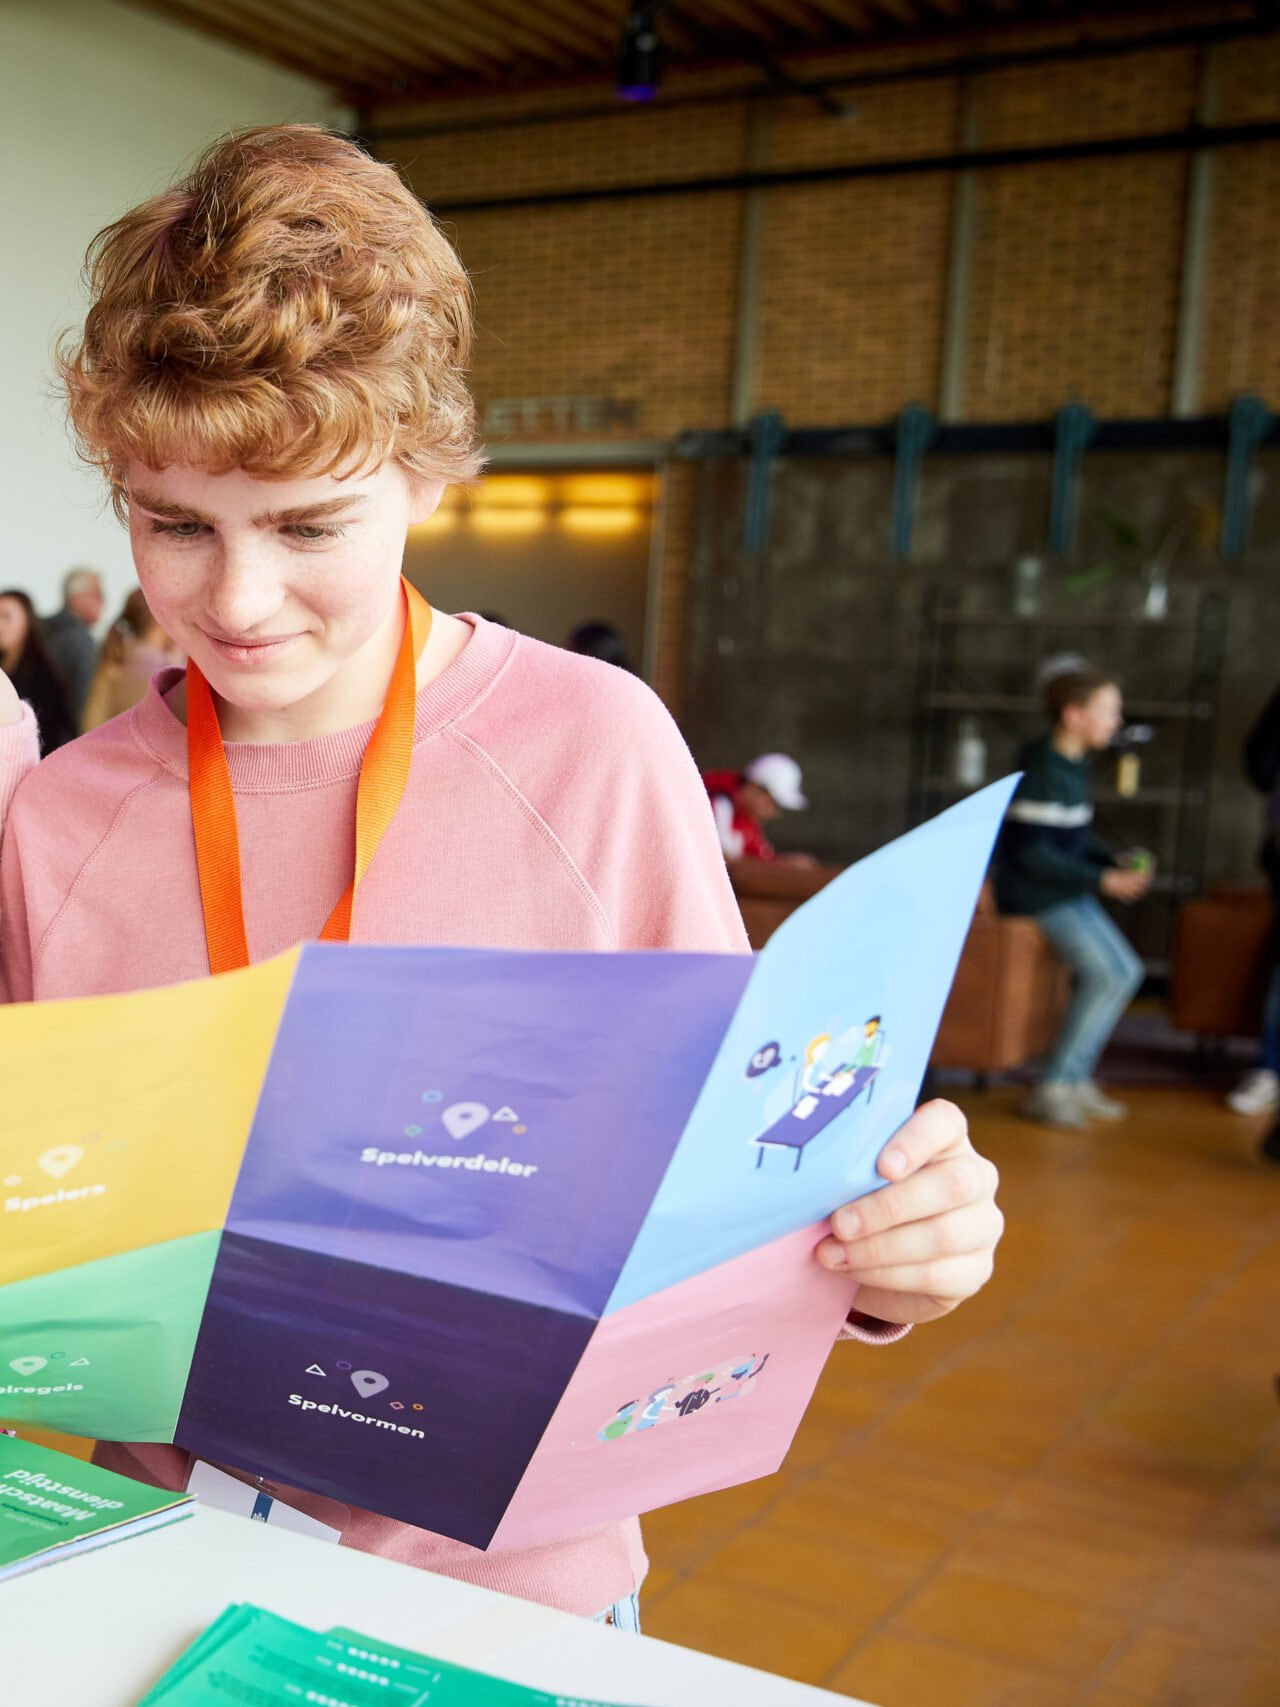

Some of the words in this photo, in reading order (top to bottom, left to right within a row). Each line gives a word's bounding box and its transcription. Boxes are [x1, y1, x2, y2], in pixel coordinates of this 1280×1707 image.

[360, 1147, 539, 1178] Spelverdeler
[4, 1183, 106, 1212] Spelers
[288, 1394, 425, 1439] Spelvormen
[4, 1469, 124, 1510] diensttijd
